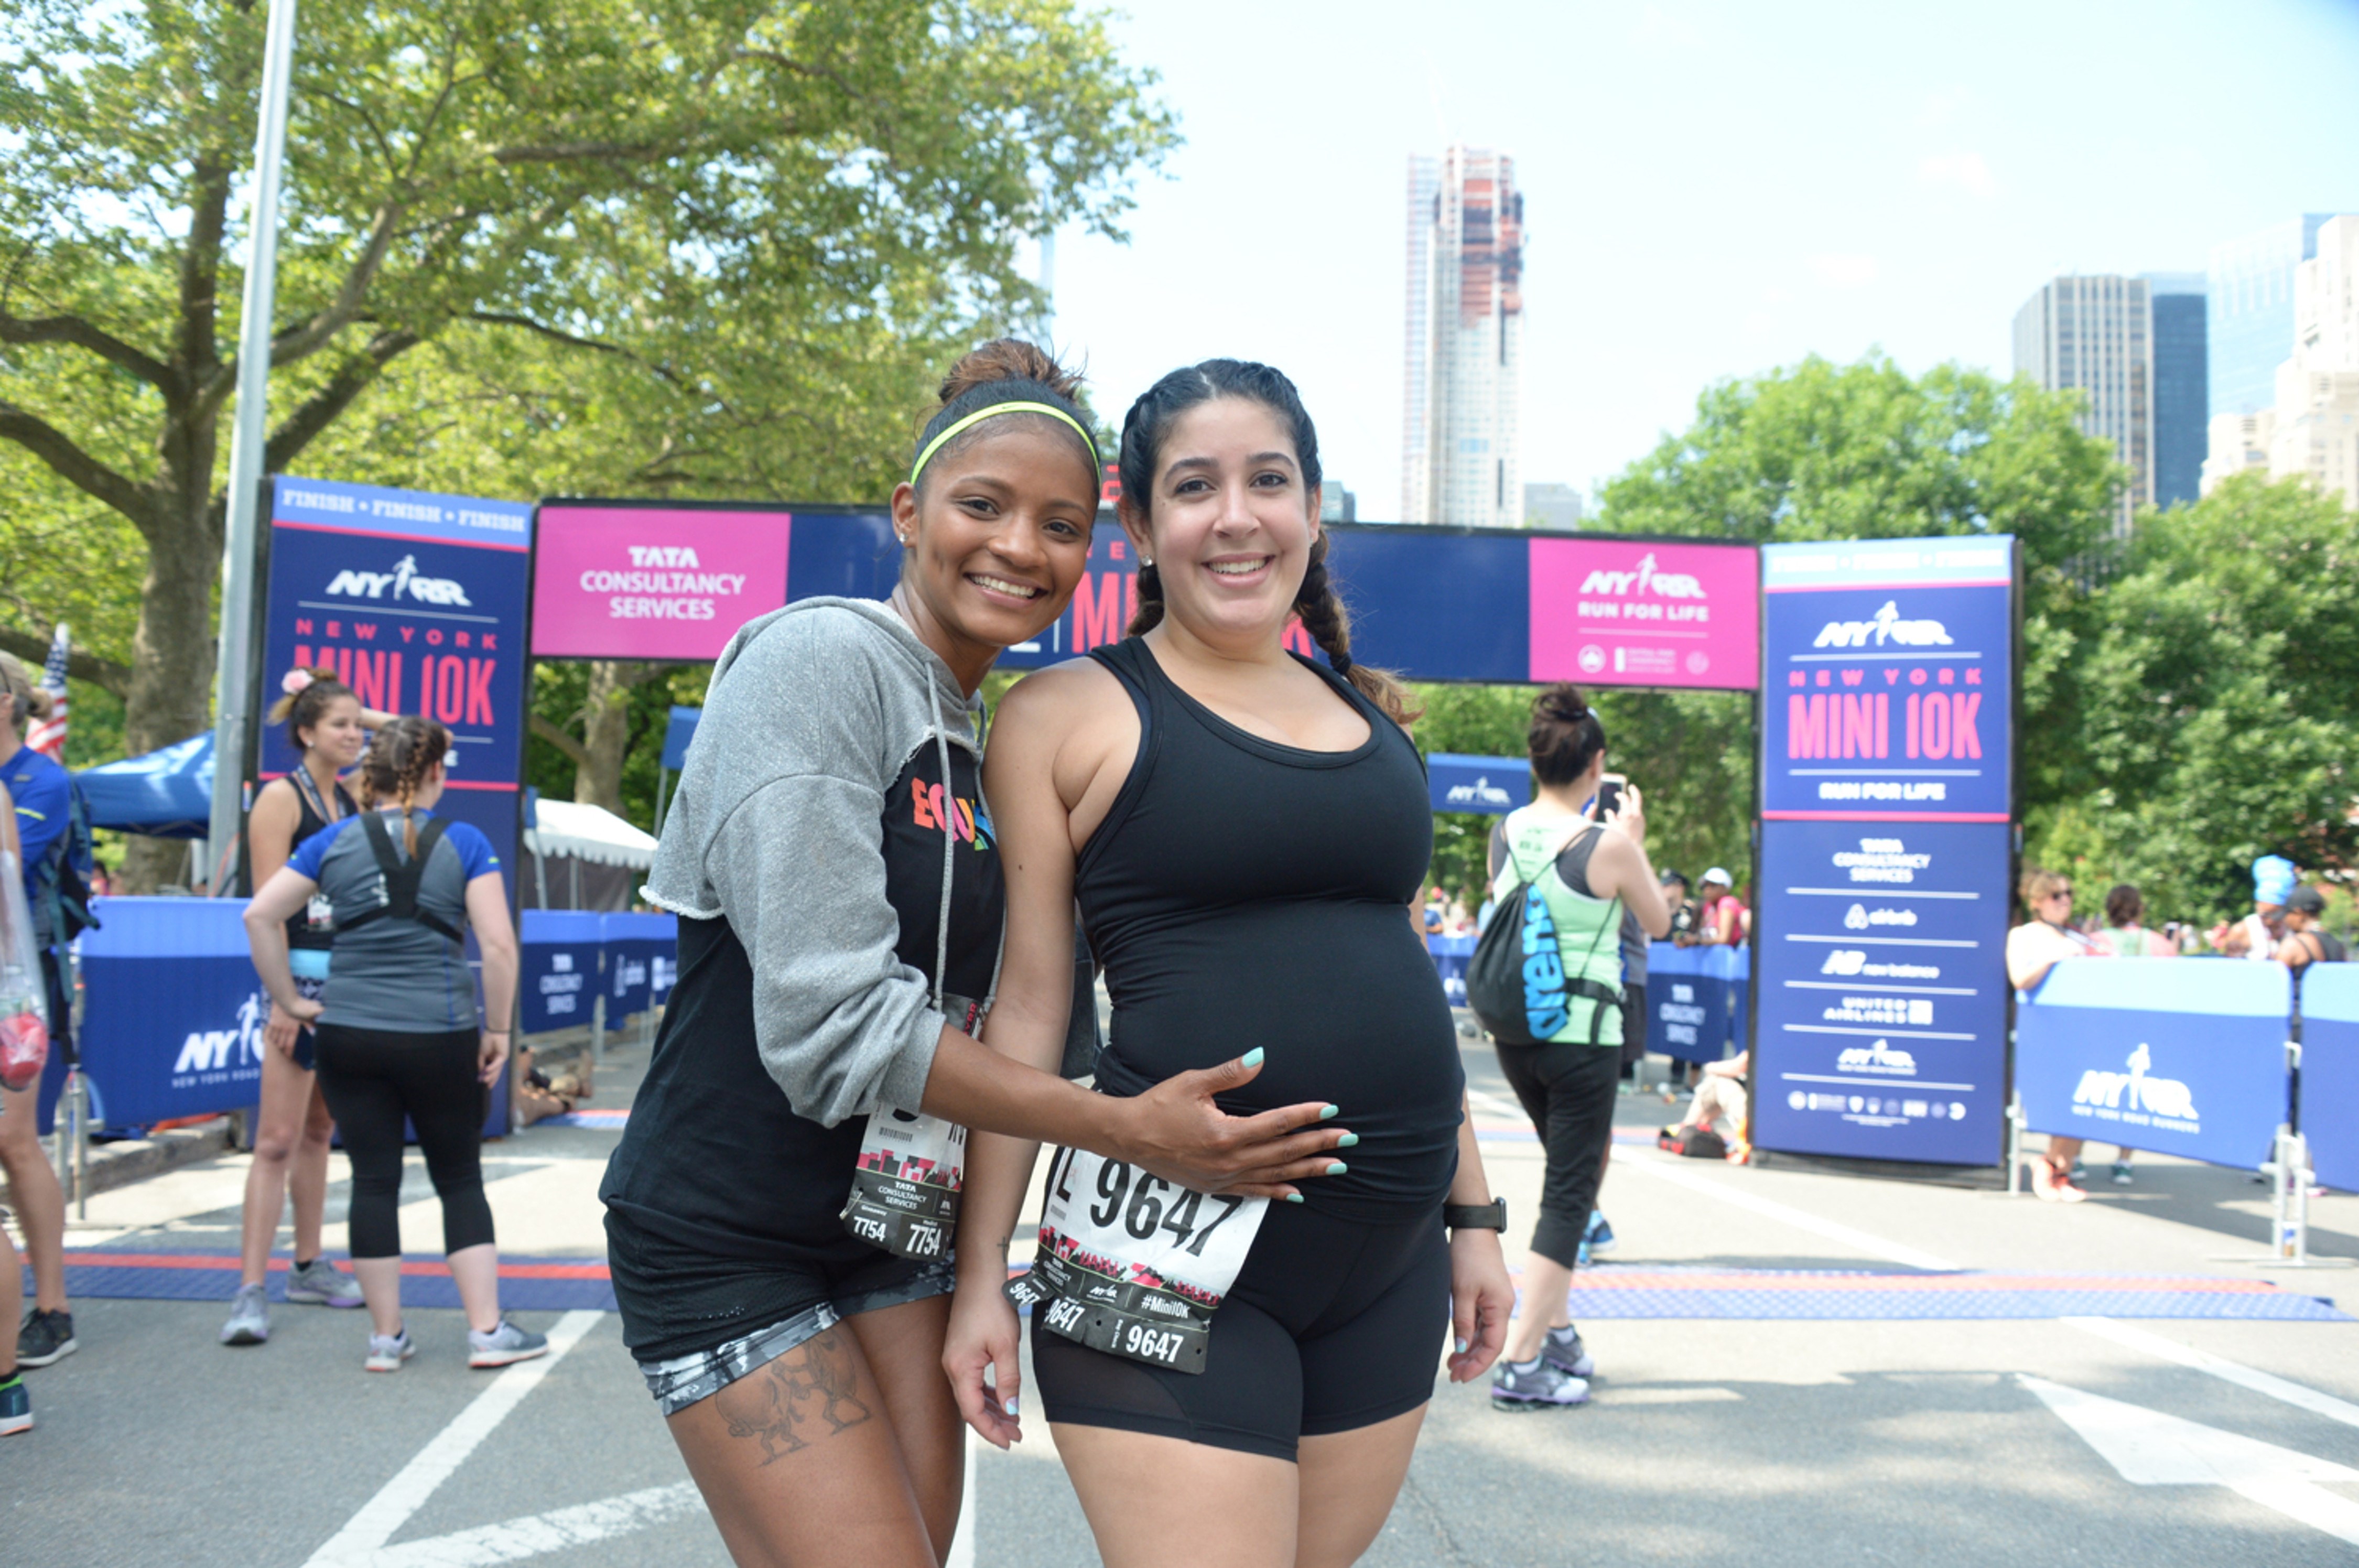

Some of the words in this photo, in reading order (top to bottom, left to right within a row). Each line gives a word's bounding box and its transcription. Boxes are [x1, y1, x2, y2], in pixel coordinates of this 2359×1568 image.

[282, 489, 355, 513] FINISH
[372, 499, 442, 523] FINISH
[459, 510, 525, 532] FINISH
[628, 546, 699, 568] TATA
[325, 569, 473, 607] NYRR
[580, 570, 746, 595] CONSULTANCY
[610, 597, 715, 620] SERVICES
[1577, 601, 1619, 618] RUN
[1624, 603, 1663, 620] FOR
[1667, 605, 1709, 622] LIFE
[295, 618, 377, 641] NEW
[399, 626, 498, 650] YORK
[420, 654, 496, 726] 10K
[1788, 669, 1864, 687] NEW
[1884, 667, 1982, 686] YORK
[1788, 693, 1888, 760] MINI
[1906, 691, 1983, 760] 10K
[895, 1181, 916, 1193] TATA
[1089, 1156, 1243, 1258] 9647
[853, 1215, 887, 1242] 7754
[905, 1223, 942, 1256] 7754
[1126, 1325, 1184, 1363] 9647
